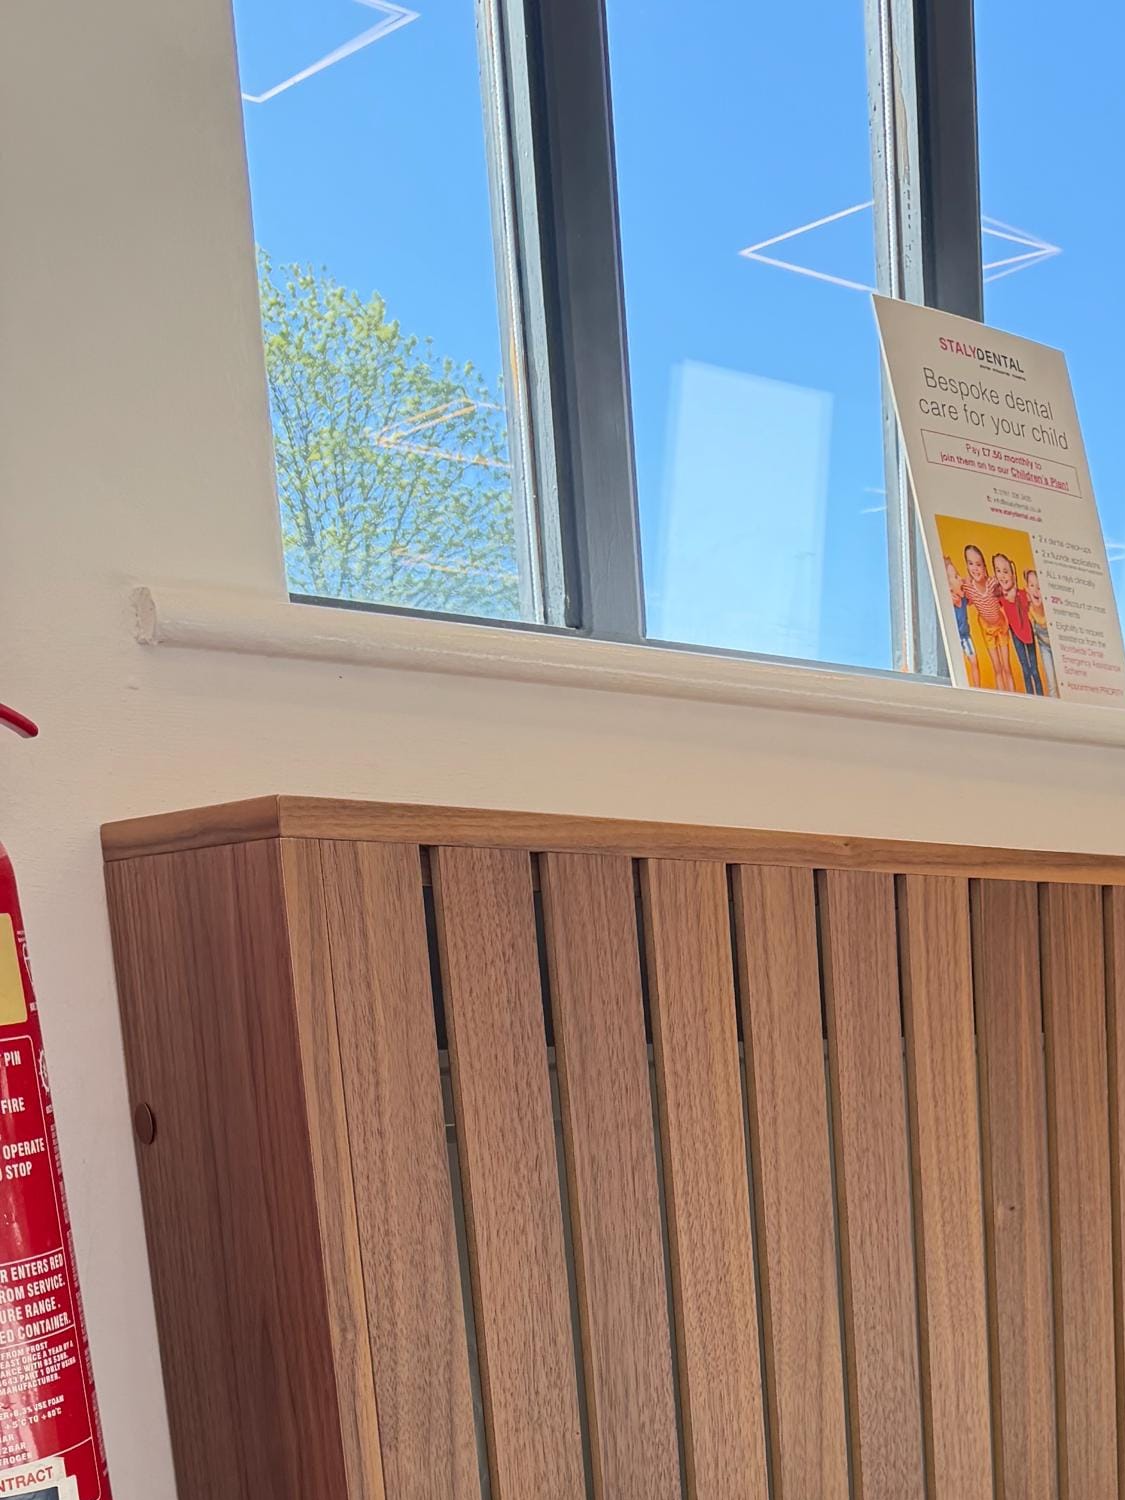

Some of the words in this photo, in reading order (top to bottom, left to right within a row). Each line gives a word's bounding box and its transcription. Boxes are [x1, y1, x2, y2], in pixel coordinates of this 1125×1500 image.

[939, 336, 1025, 373] STALYDENTAL
[923, 367, 1000, 405] Bespoke
[1004, 390, 1054, 421] dental
[919, 398, 959, 421] care
[963, 403, 985, 427] for
[990, 415, 1025, 438] your
[1032, 426, 1069, 450] child
[940, 451, 955, 463] join
[957, 456, 976, 467] them
[977, 461, 987, 470] on
[987, 463, 996, 472] to
[997, 467, 1009, 475] our
[965, 443, 980, 457] Pay
[1004, 454, 1033, 469] monthly
[1034, 461, 1042, 471] to
[4, 1050, 21, 1066] PIN
[1, 1097, 25, 1114] FIRE
[3, 1138, 45, 1160] OPERATE
[5, 1161, 32, 1180] STOP
[10, 1259, 49, 1281] ENTERS
[49, 1253, 64, 1270] RED
[27, 1274, 65, 1298] SERVICE.
[18, 1312, 71, 1340] CONTAINER.
[1, 1348, 24, 1360] FROM
[26, 1341, 48, 1354] FROST
[22, 1352, 41, 1364] ONCE
[43, 1350, 47, 1358] A
[48, 1344, 63, 1355] YEAR
[19, 1371, 38, 1381] PART
[46, 1363, 60, 1374] ONLY
[24, 1361, 43, 1372] WITH
[48, 1394, 64, 1406] FOAM
[28, 1415, 39, 1424] TO
[0, 1433, 14, 1443] AR
